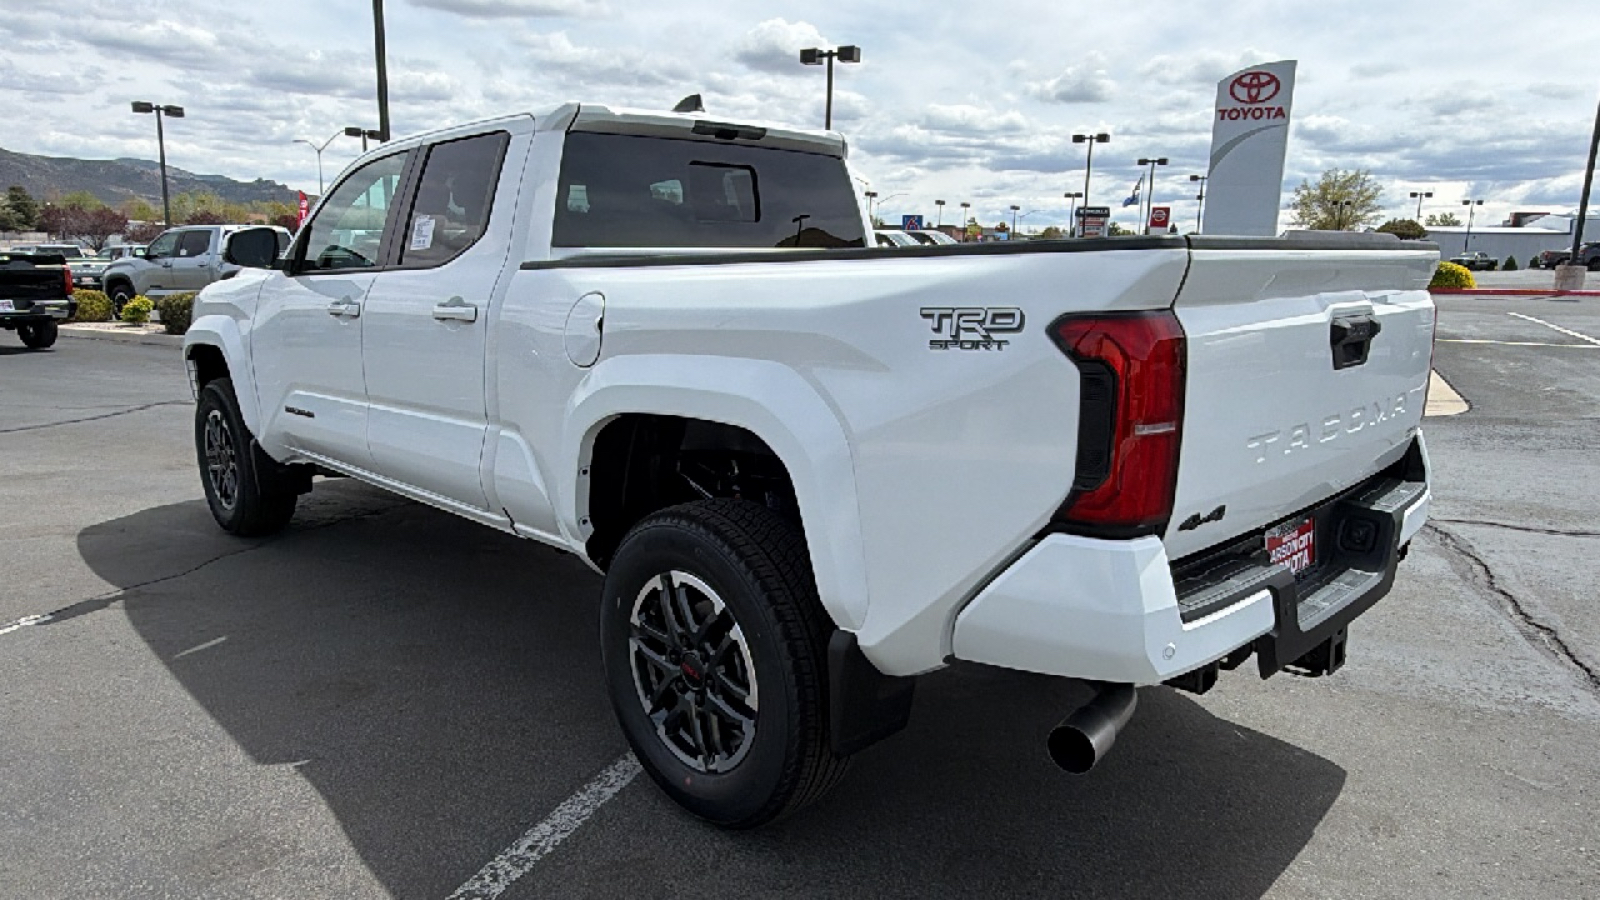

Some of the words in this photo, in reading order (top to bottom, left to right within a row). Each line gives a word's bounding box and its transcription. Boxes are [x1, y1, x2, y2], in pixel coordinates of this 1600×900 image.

[1218, 106, 1286, 121] TOYOTA
[919, 307, 1025, 341] TRD
[929, 340, 1010, 351] SPORT
[1247, 392, 1407, 464] TACOMA
[1299, 530, 1315, 551] CITY
